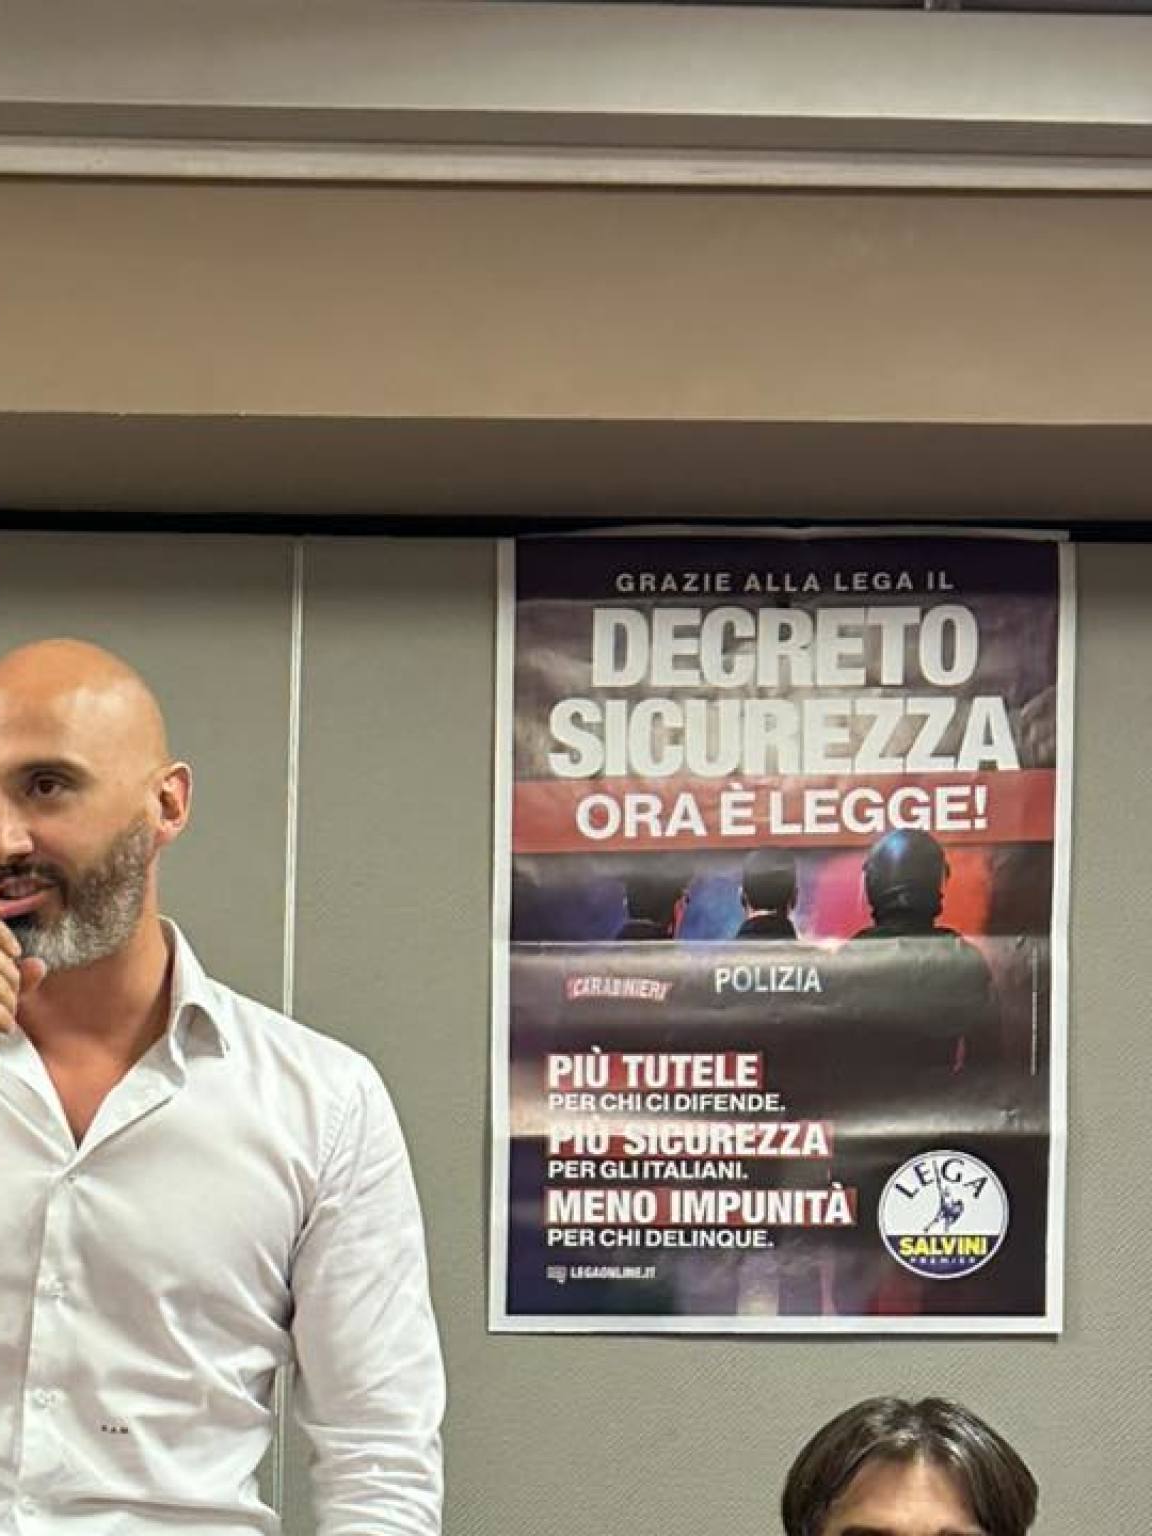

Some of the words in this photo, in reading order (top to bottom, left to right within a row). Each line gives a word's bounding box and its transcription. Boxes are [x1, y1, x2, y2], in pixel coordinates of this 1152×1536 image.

[615, 571, 731, 592] GRAZIE
[744, 572, 820, 592] ALLA
[833, 571, 913, 592] LEGA
[927, 570, 953, 591] IL
[591, 604, 979, 688] DECRETO
[548, 696, 1020, 777] SICUREZZA
[576, 793, 706, 840] ORA
[720, 782, 755, 835] È
[770, 785, 987, 834] LEGGE!
[714, 965, 822, 993] POLIZIA
[549, 1045, 608, 1088] PIÙ
[623, 1055, 758, 1088] TUTELE
[549, 1093, 595, 1112] PER
[600, 1093, 641, 1112] CHI
[646, 1093, 668, 1112] CI
[674, 1093, 786, 1112] DIFENDE.
[624, 1121, 829, 1155] SICUREZZA
[549, 1161, 595, 1179] PER
[600, 1161, 638, 1179] GLI
[644, 1161, 748, 1179] ITALIANI.
[895, 1158, 987, 1199] LEGA
[549, 1189, 657, 1223] MENO
[671, 1181, 853, 1224] IMPUNITÀ
[548, 1229, 594, 1247] PER
[599, 1229, 640, 1247] CHI
[647, 1229, 774, 1247] DELINQUE.
[899, 1236, 987, 1255] SALVINI
